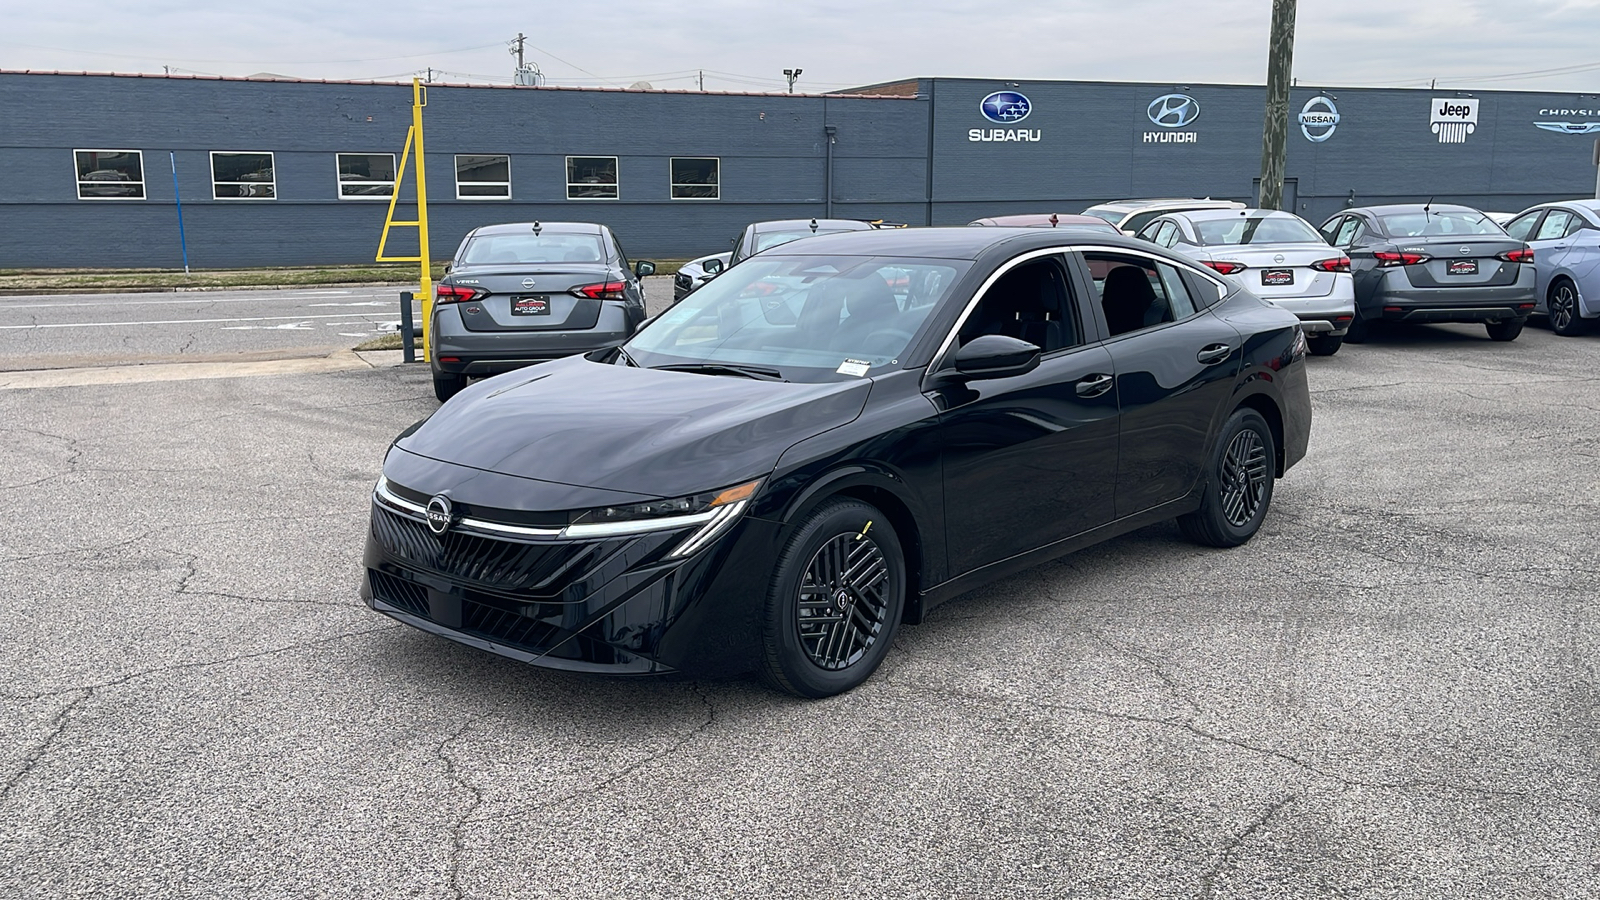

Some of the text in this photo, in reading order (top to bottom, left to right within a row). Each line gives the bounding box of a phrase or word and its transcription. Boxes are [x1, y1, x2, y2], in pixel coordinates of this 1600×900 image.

[1440, 102, 1470, 119] Jeep
[1302, 115, 1336, 123] NISSAN
[968, 129, 1041, 142] SUBARU
[1143, 132, 1197, 143] HYUNDAI
